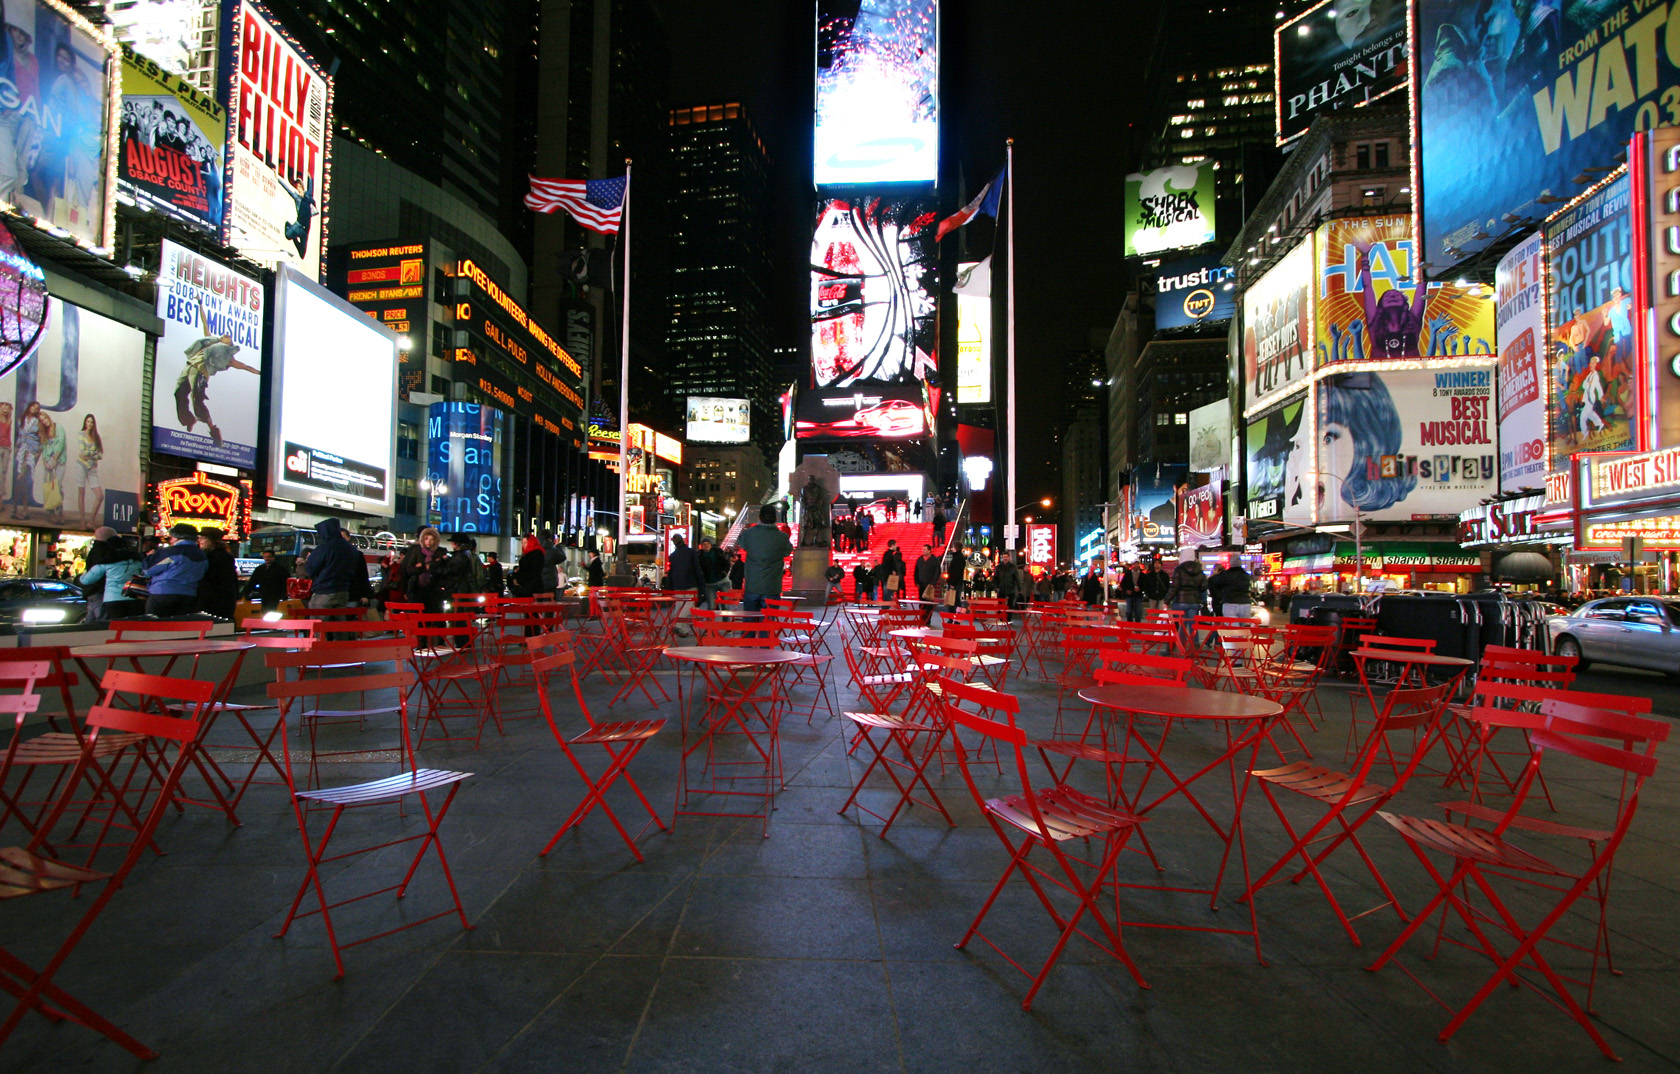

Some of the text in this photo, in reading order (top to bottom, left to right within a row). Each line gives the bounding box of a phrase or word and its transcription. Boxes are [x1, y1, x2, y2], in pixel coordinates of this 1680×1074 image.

[1558, 28, 1599, 70] FROM
[1602, 5, 1629, 38] THE
[1333, 30, 1404, 72] Tonight belongs to
[121, 43, 222, 116] BEST PLAY
[241, 9, 312, 129] BILLY
[238, 78, 319, 190] ELLIOT
[309, 121, 320, 142] THE
[128, 168, 208, 198] OSAGE COUNTY
[1138, 190, 1200, 219] SHREK
[1577, 206, 1584, 220] 7
[1585, 194, 1605, 216] TONY
[1143, 207, 1200, 231] MUSICAL
[1343, 219, 1369, 230] THE
[1375, 217, 1405, 228] SUN
[1566, 212, 1601, 243] MUSICAL
[351, 244, 423, 259] THOMSON REUTERS
[1514, 247, 1526, 265] FOR
[1526, 239, 1541, 258] YOU
[361, 270, 386, 281] BONDS
[1532, 252, 1539, 283] I
[176, 250, 260, 312] HEIGHTS
[169, 279, 259, 327] 2008 TONY AWARD
[349, 291, 377, 301] FRENCH
[1188, 297, 1211, 310] TNT
[167, 294, 259, 350] BEST MUSICAL
[384, 310, 405, 320] PRICE
[486, 277, 528, 329] VOLUNTEERS:
[528, 318, 549, 348] MAKING
[547, 335, 558, 356] THE
[557, 345, 582, 380] DIFFERENCE
[1257, 318, 1299, 365] JERSEY BOYS
[484, 319, 500, 345] GAIL
[507, 337, 527, 365] PULEO
[535, 361, 553, 385] HOLLY
[1432, 387, 1490, 397] 8 TONY AWARDS 2003
[1435, 371, 1491, 389] WINNER!
[1451, 395, 1490, 420] BEST
[449, 431, 493, 443] Morgan Stanley
[1420, 420, 1492, 446] MUSICAL
[1514, 438, 1545, 466] HBO
[1365, 453, 1494, 482] hairspray
[1524, 461, 1545, 475] THEATRE
[1608, 458, 1650, 491] WEST
[1188, 489, 1210, 509] go red
[112, 503, 133, 522] GAP
[1032, 527, 1053, 563] tkts
[1595, 530, 1637, 539] OPENING
[1638, 530, 1672, 539] NIGHT:
[1387, 555, 1426, 565] sbarro
[1435, 555, 1476, 566] sbarro
